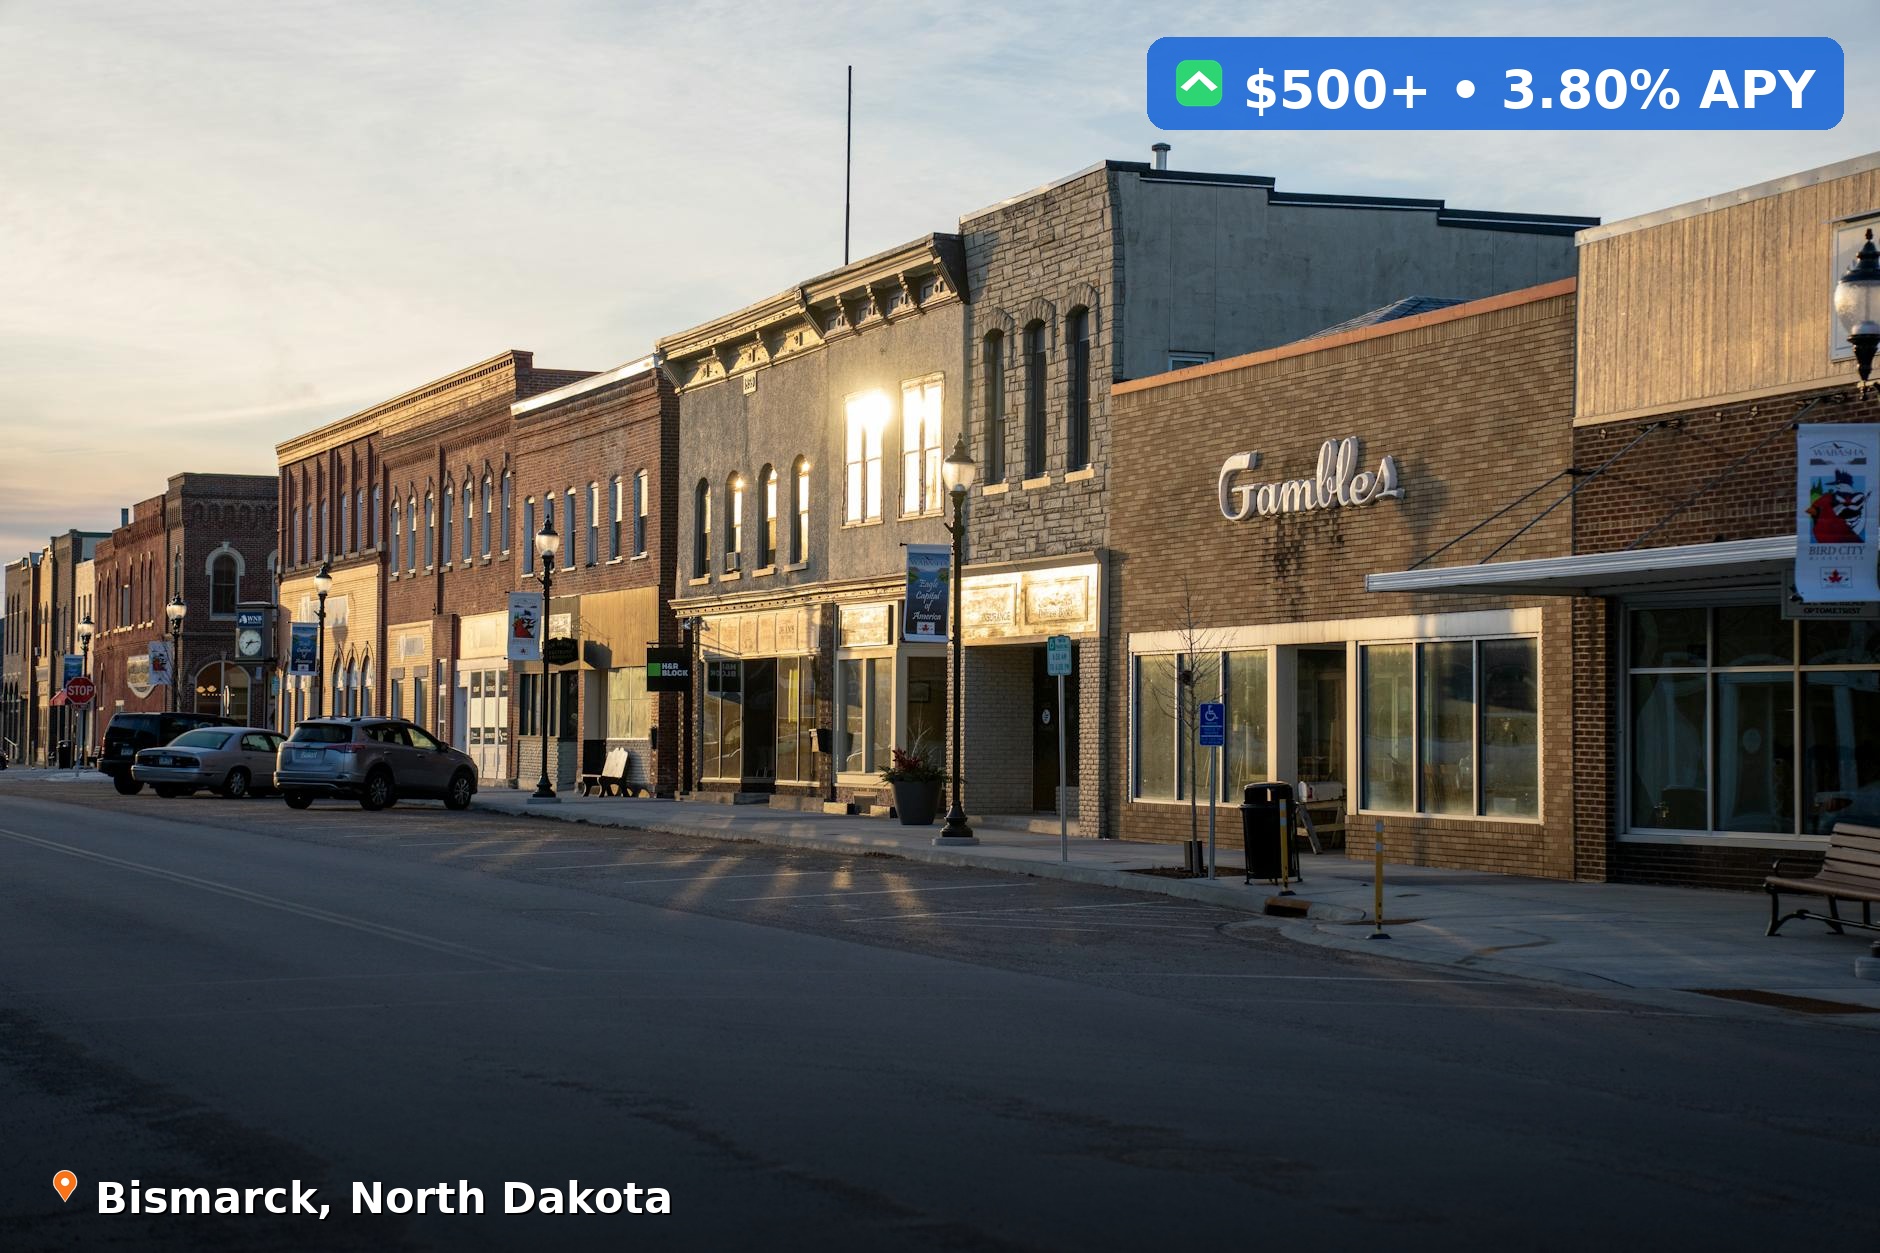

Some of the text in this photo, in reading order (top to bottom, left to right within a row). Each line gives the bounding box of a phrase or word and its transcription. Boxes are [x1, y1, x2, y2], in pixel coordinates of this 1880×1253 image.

[1813, 448, 1865, 456] WABASHA
[1218, 436, 1405, 521] Gambles
[1809, 546, 1865, 555] BIRD CITY
[919, 579, 938, 592] Eagle
[916, 591, 942, 603] Capital
[924, 600, 933, 612] of
[912, 611, 941, 620] America
[662, 662, 679, 670] H&R
[68, 685, 93, 697] STOP
